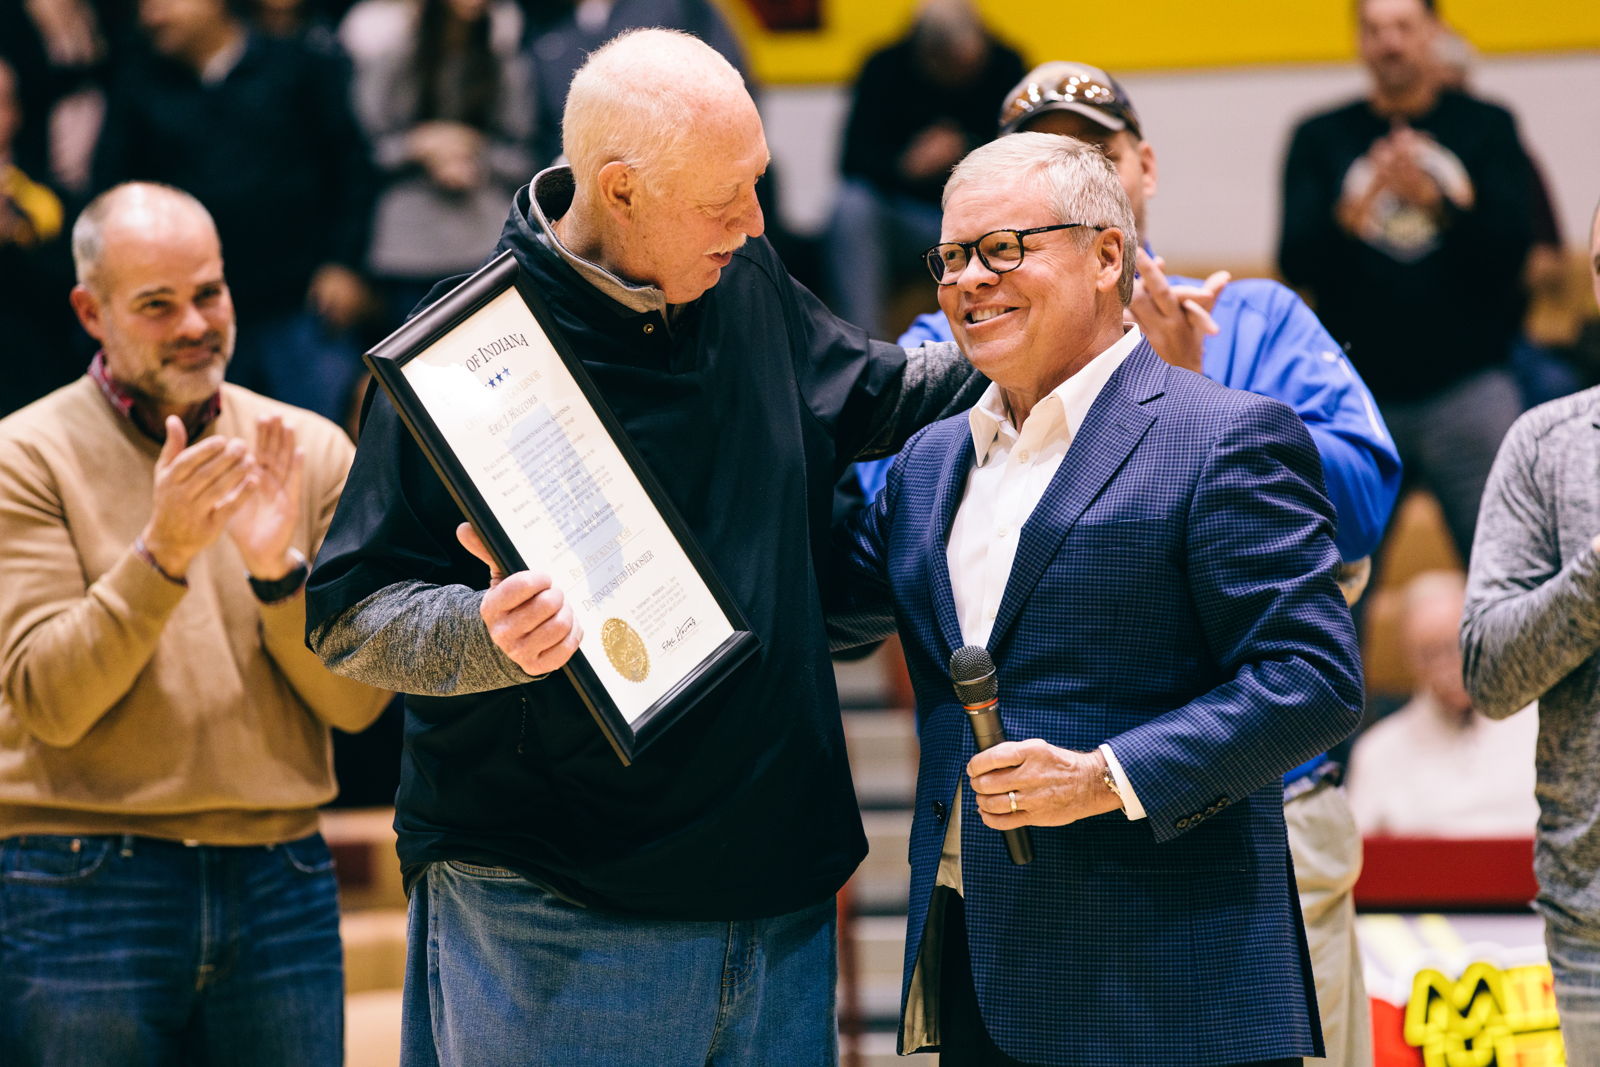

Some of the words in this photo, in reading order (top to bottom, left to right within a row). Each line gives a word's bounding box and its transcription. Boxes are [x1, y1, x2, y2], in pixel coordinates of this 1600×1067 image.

[465, 354, 481, 372] OF
[477, 333, 529, 363] INDIANA
[582, 569, 628, 611] DISTINGUISHED
[624, 549, 655, 576] HOOSIER
